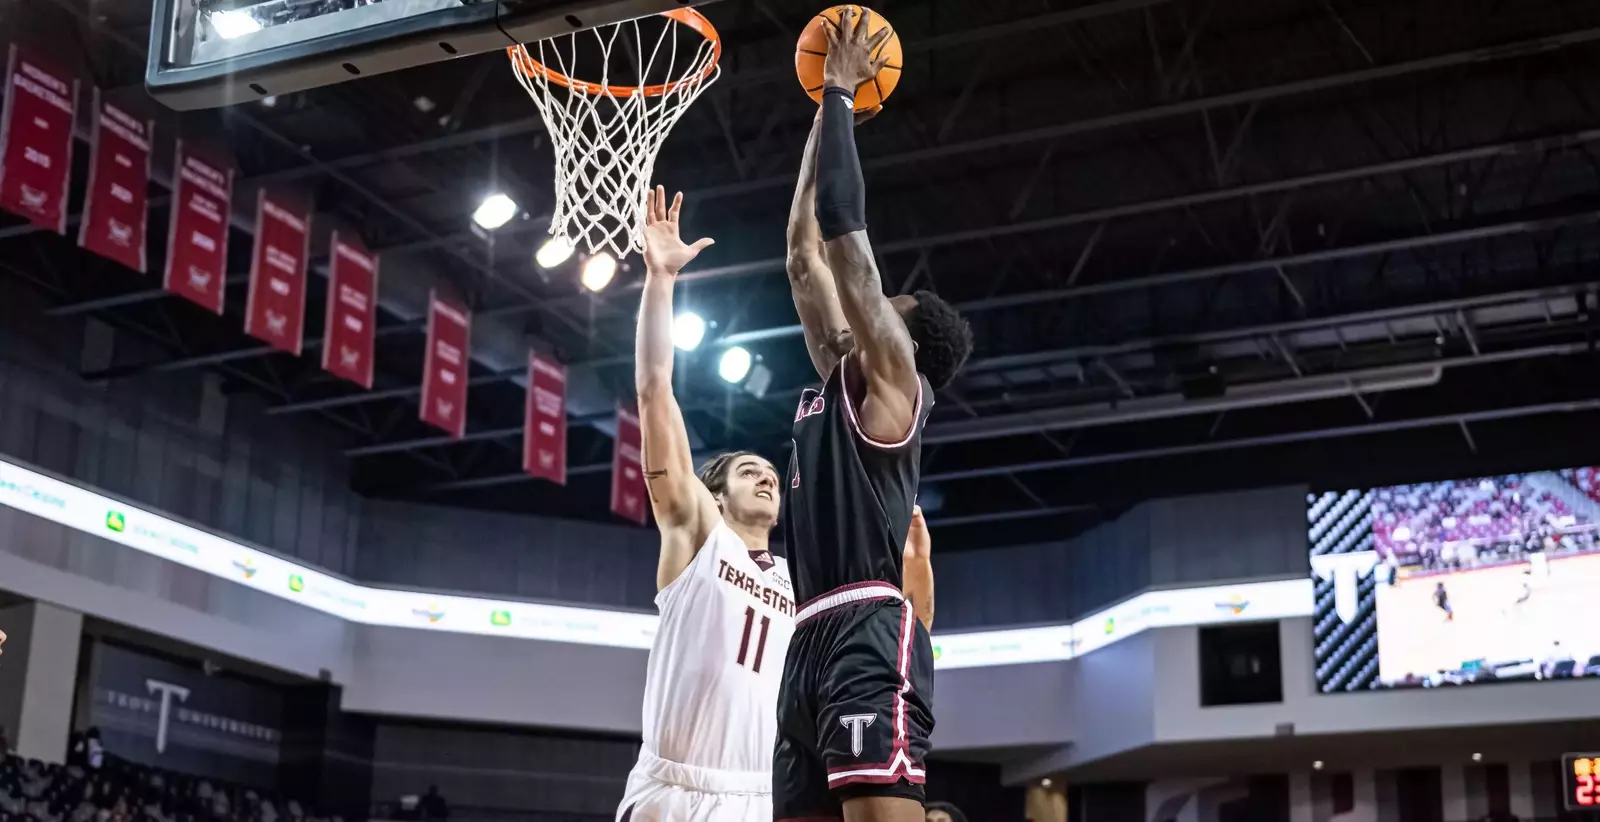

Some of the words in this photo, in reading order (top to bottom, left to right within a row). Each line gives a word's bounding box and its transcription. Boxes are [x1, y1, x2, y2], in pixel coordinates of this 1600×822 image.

[717, 558, 762, 600] TEXAS
[762, 586, 795, 619] STAT
[736, 604, 771, 674] 11
